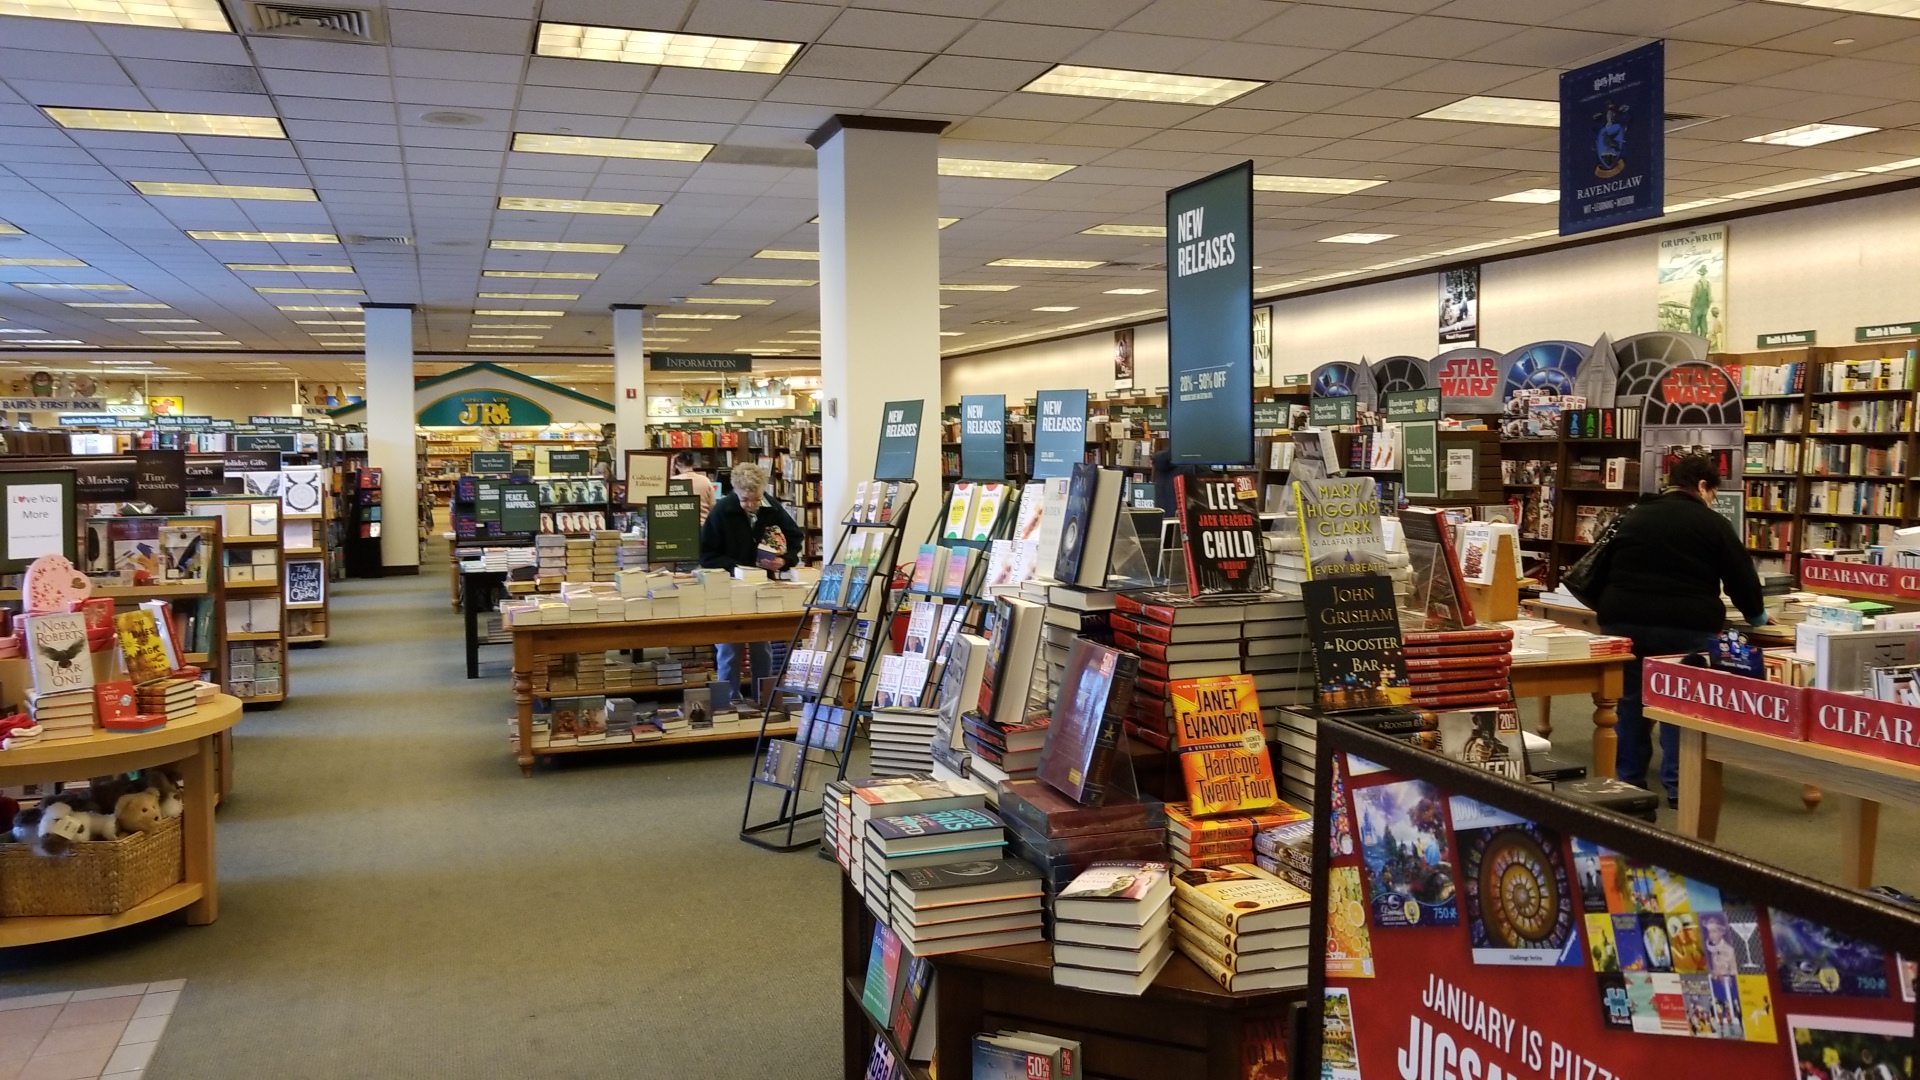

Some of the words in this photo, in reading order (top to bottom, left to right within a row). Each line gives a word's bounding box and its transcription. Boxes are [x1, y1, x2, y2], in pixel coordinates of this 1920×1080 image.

[1577, 174, 1643, 200] RAVENCLAW
[1177, 206, 1204, 244] NEW
[1661, 236, 1690, 248] GRAPES
[1695, 231, 1723, 243] WRATH
[1177, 232, 1236, 278] RELEASES
[1255, 344, 1270, 360] IND
[666, 357, 736, 368] INFORMATION
[1439, 358, 1498, 378] STAR
[1198, 372, 1213, 390] 50%
[1213, 370, 1227, 388] OFF
[1662, 367, 1727, 386] STAR
[1440, 377, 1498, 397] WARS
[1662, 385, 1727, 404] WARS
[3, 400, 37, 409] BABY'S
[41, 400, 69, 409] FIRST
[73, 401, 101, 409] BOOK
[967, 405, 983, 419] NEW
[1043, 400, 1062, 415] NEW
[1314, 402, 1337, 412] Paperback
[888, 410, 904, 423] NEW
[1314, 411, 1337, 420] Bestsellers
[885, 424, 917, 438] RELEASES
[966, 420, 1001, 435] RELEASES
[1042, 416, 1082, 432] RELEASES
[143, 472, 166, 482] Tiny
[185, 466, 213, 475] Cards
[86, 475, 130, 485] Markers
[40, 494, 58, 503] You
[505, 493, 523, 501] PEACE
[523, 493, 529, 501] &
[1206, 483, 1238, 510] LEE
[1318, 483, 1361, 500] MARY
[505, 501, 536, 509] HAPPINESS
[655, 503, 674, 511] BARNES
[1307, 500, 1377, 518] HIGGINS
[22, 510, 49, 519] More
[1199, 514, 1218, 526] JACK
[1220, 514, 1253, 526] REACHER
[1318, 520, 1372, 537] CLARK
[1202, 530, 1255, 559] CHILD
[1322, 537, 1353, 546] ALAFAIR
[1357, 536, 1380, 544] BURKE
[1315, 564, 1346, 575] EVERY
[1350, 563, 1386, 573] BREATH
[1805, 566, 1889, 587] CLEARANCE
[1332, 586, 1375, 604] JOHN
[911, 618, 930, 629] FURY
[1321, 608, 1394, 625] GRISHAM
[41, 621, 78, 632] NORA
[36, 630, 84, 645] ROBERTS
[1323, 641, 1334, 650] The
[1335, 637, 1400, 653] ROOSTER
[45, 663, 82, 677] YEAR
[1351, 657, 1381, 673] BAR
[52, 675, 82, 687] ONE
[880, 673, 898, 684] FURY
[902, 676, 922, 687] FURY
[1196, 688, 1237, 713] JANET
[1650, 672, 1790, 723] CLEARANCE
[1194, 743, 1226, 751] STEPHANIE
[1245, 735, 1261, 743] SIGNED
[1203, 751, 1261, 780] Hardcore
[1470, 758, 1521, 780] IFFIN
[1195, 776, 1272, 807] Twenty-Four
[1218, 881, 1282, 894] BERNARD
[1434, 908, 1449, 919] 750
[880, 926, 894, 942] BRAIN
[874, 935, 897, 960] SOLUTION
[1422, 973, 1516, 1054] JANUARY
[1398, 1014, 1519, 1080] JIGS
[1521, 1025, 1543, 1071] IS
[1551, 1040, 1623, 1080] PUZ
